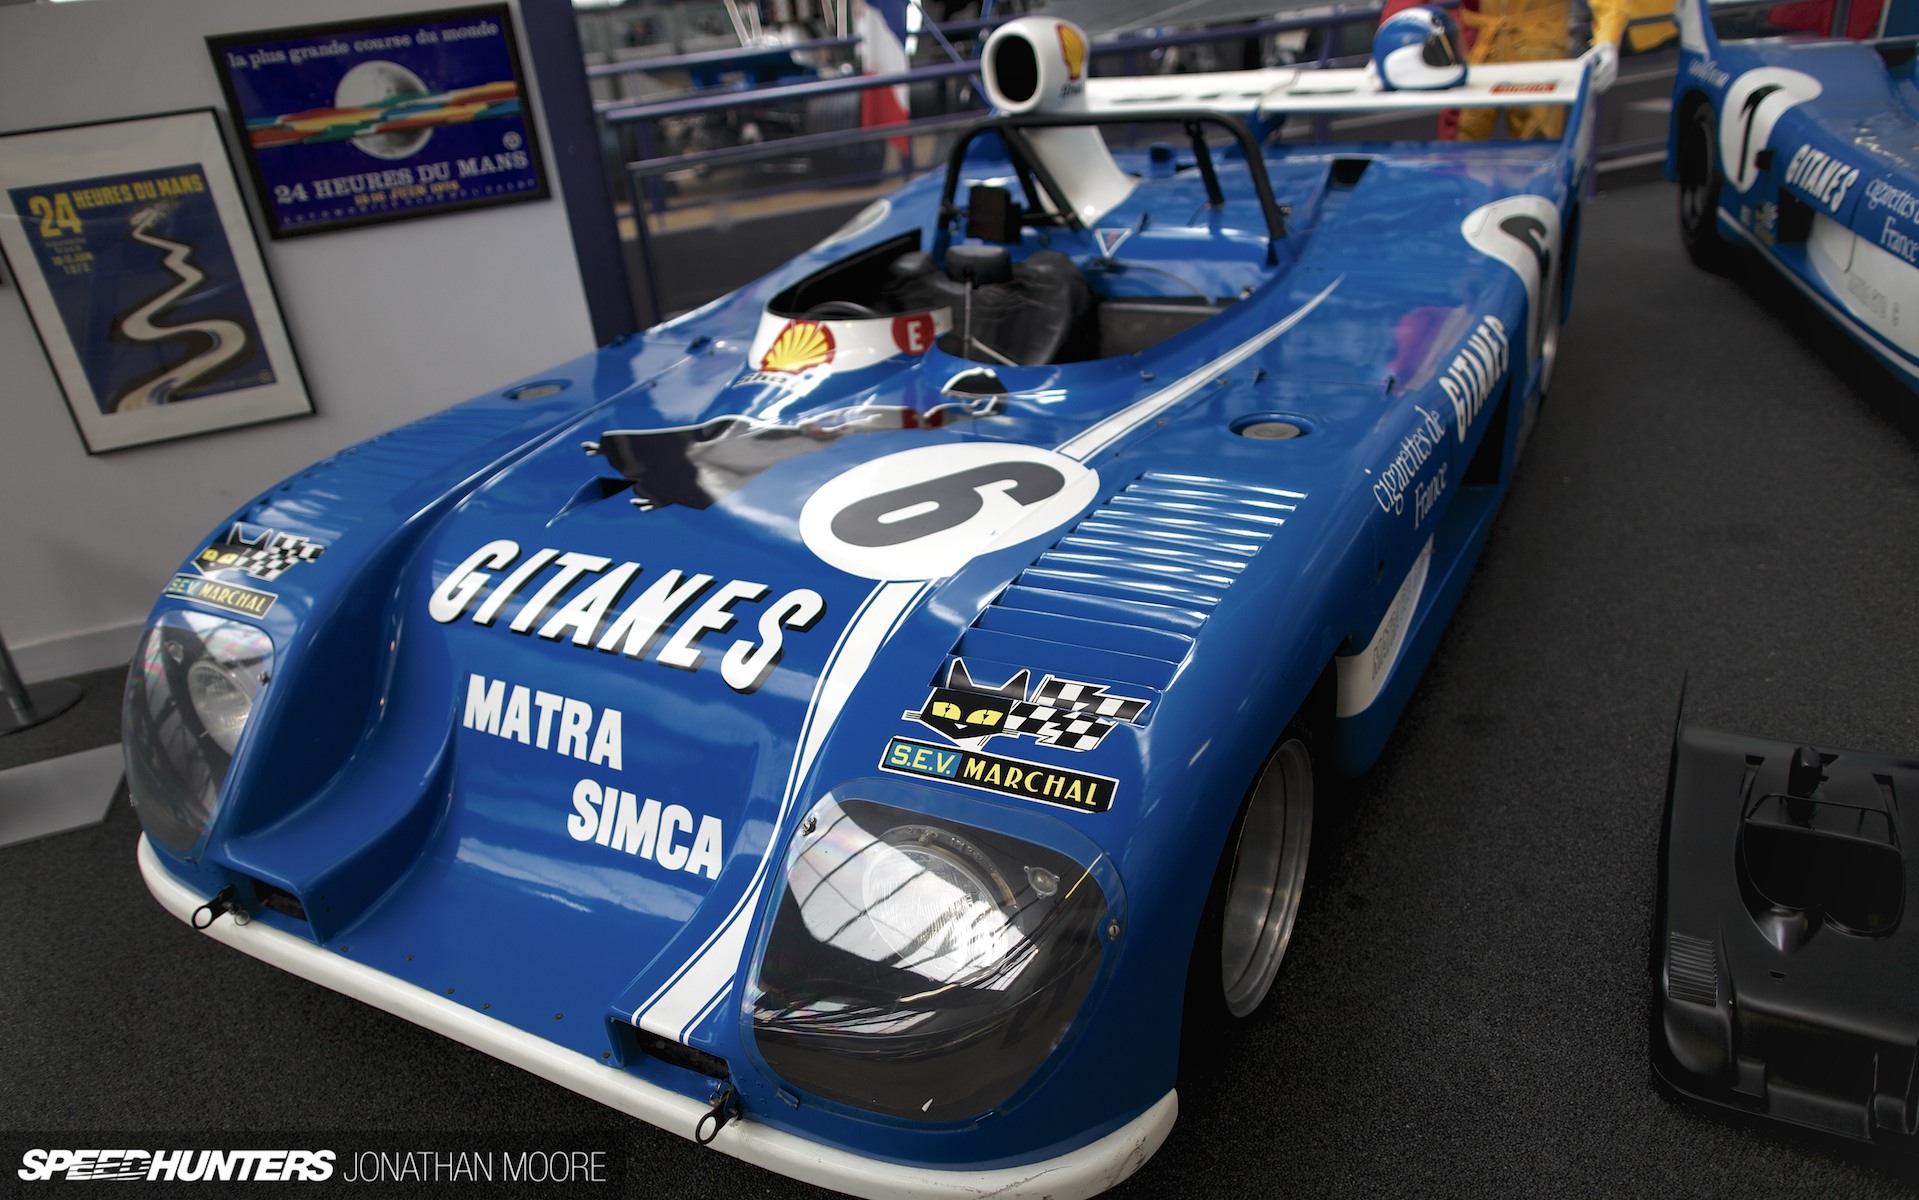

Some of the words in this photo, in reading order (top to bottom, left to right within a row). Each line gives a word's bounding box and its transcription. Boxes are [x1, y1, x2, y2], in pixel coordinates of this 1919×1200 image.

[227, 52, 248, 68] la
[250, 46, 287, 70] plus
[289, 40, 350, 64] grande
[353, 34, 412, 52] course
[415, 28, 439, 44] du
[441, 20, 499, 42] monde
[28, 192, 83, 238] 24
[72, 183, 134, 209] HEURES
[132, 179, 157, 200] DU
[156, 173, 204, 196] MANS
[274, 182, 309, 204] 24
[312, 167, 414, 199] HEURES
[416, 161, 451, 184] DU
[456, 150, 528, 178] MANS
[1785, 143, 1860, 213] GITANES
[1864, 173, 1916, 218] cigarettes
[1881, 215, 1919, 262] France
[907, 320, 924, 352] E
[1439, 315, 1509, 444] GITANES
[1365, 427, 1432, 515] cigarettes
[1414, 405, 1446, 444] de
[830, 461, 1065, 547] 6
[1414, 461, 1448, 530] France
[199, 581, 268, 613] MARCHAL
[428, 539, 826, 695] GITANES
[463, 673, 622, 771] MATRA
[890, 744, 956, 775] S.E.V.
[963, 757, 1098, 806] MARCHAL
[567, 778, 722, 880] SIMCA
